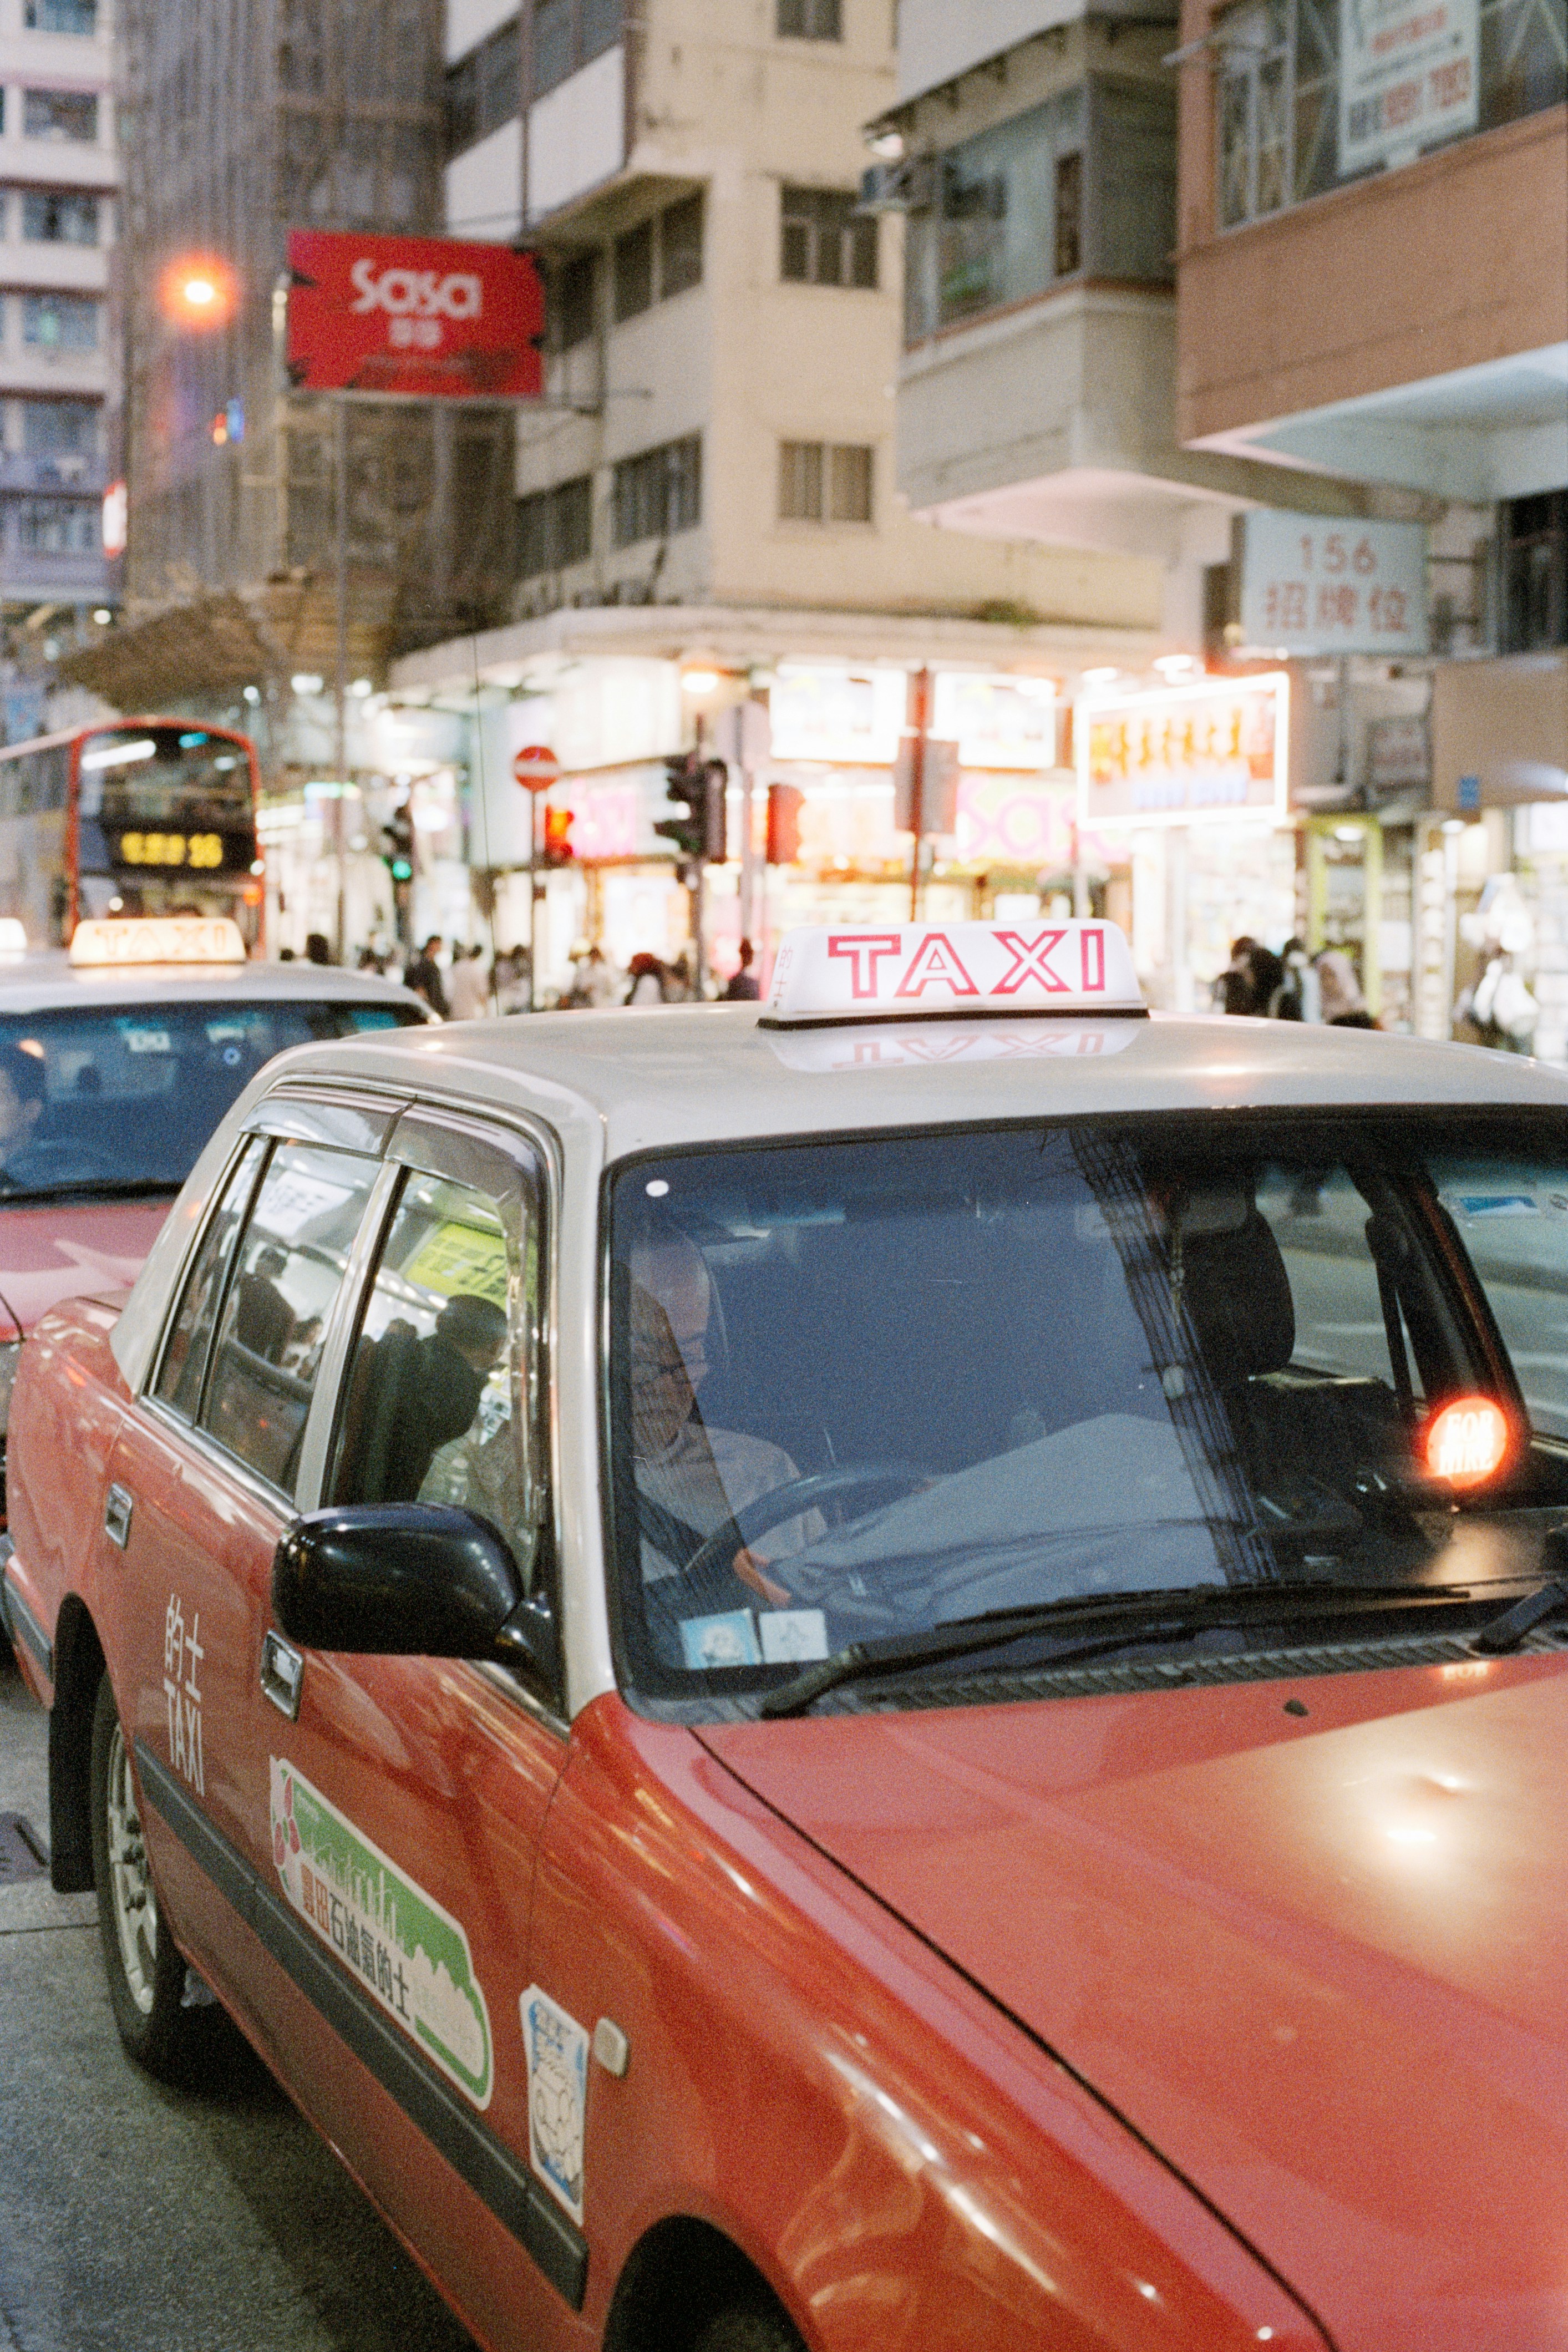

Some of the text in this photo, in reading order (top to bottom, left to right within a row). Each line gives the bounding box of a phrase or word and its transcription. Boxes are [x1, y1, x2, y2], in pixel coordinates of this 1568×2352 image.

[1301, 534, 1378, 575] 156
[94, 923, 227, 956] TAXI
[774, 945, 794, 997] 的士
[828, 929, 1105, 999] TAXI
[1444, 1410, 1494, 1443] FOR
[1438, 1441, 1493, 1475] HIRE
[165, 1593, 204, 1702] 的士
[164, 1677, 205, 1797] TAXI
